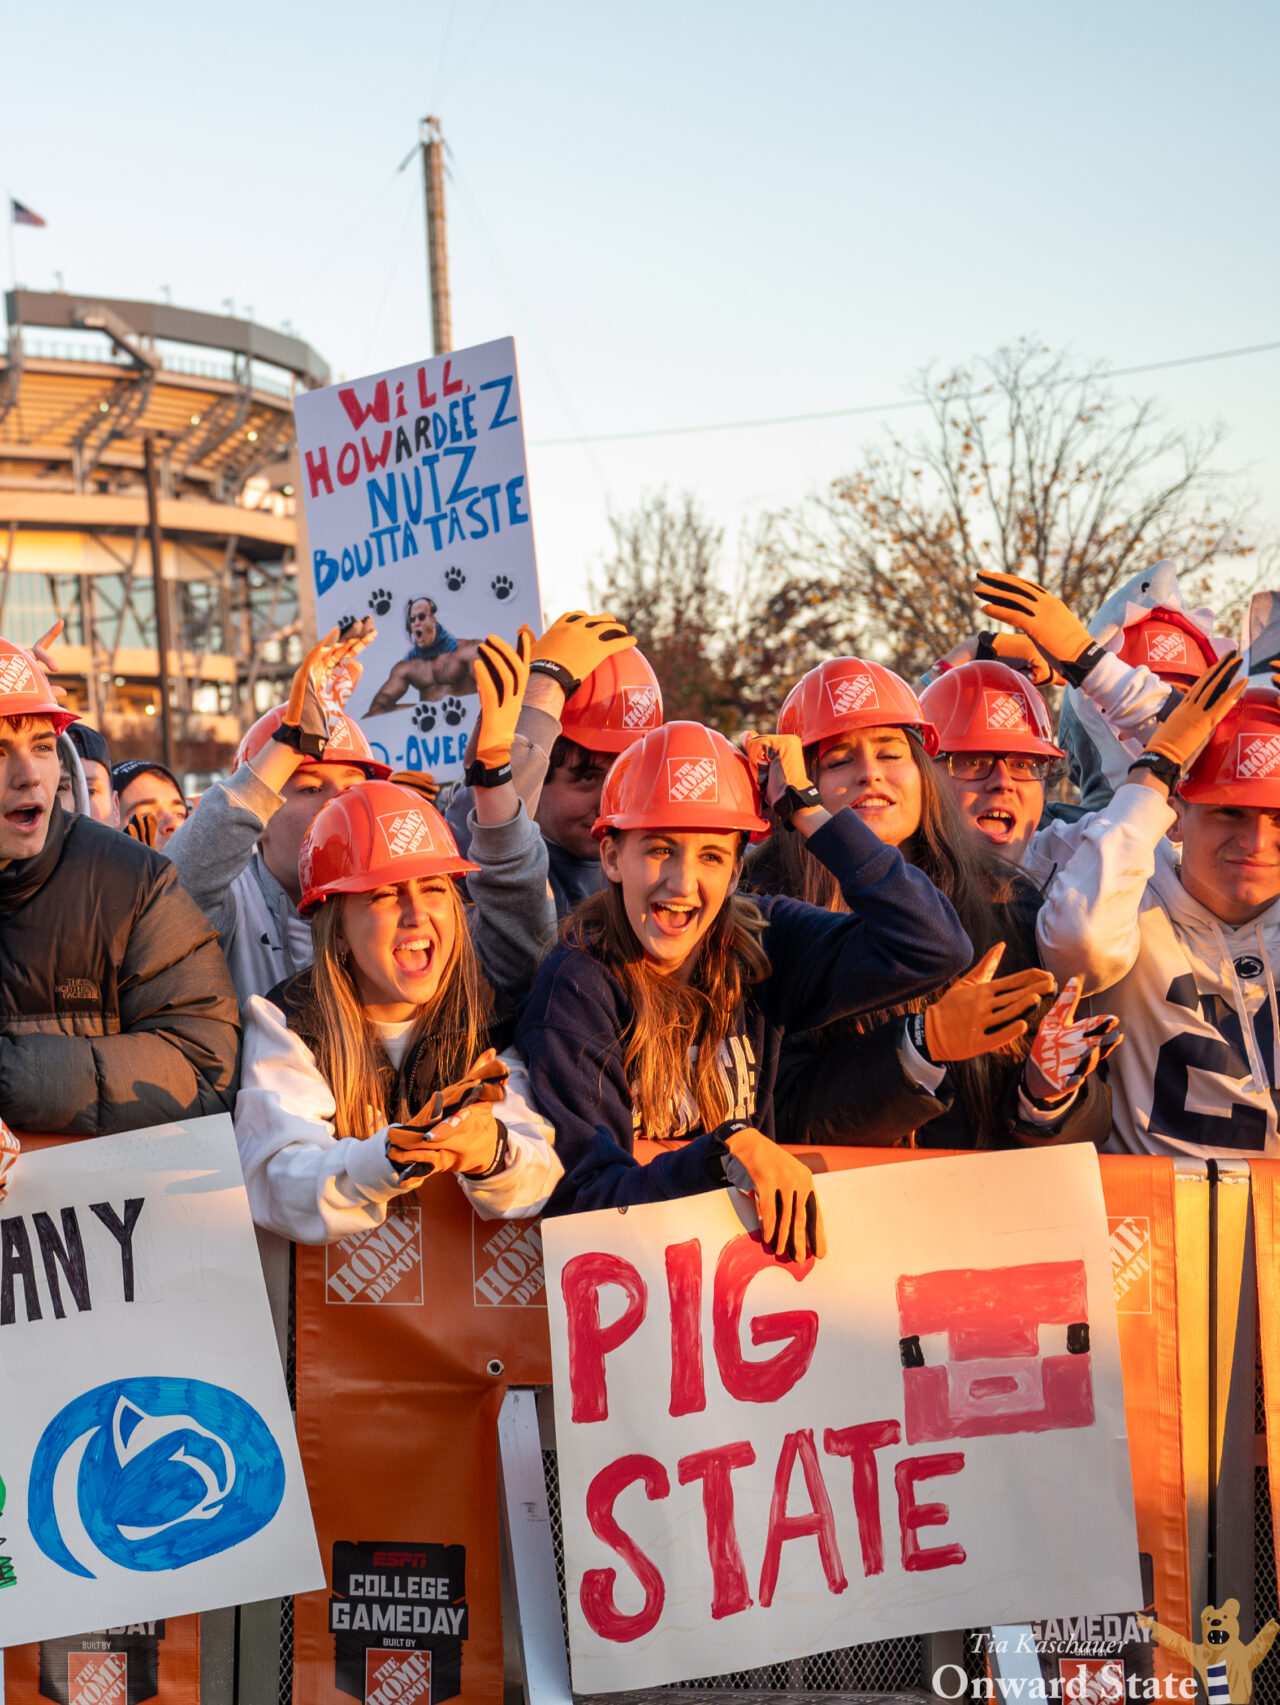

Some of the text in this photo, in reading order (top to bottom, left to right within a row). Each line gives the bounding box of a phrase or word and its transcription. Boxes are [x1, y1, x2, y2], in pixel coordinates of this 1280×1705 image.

[367, 445, 479, 527] NUTZ
[314, 475, 529, 597] BOUTTA TASTE
[1148, 632, 1184, 662] HOME
[1152, 633, 1166, 645] THE
[1164, 645, 1186, 662] DEPOT
[14, 667, 33, 693] DEPOT
[834, 679, 852, 697] THE
[834, 674, 872, 714] HOME
[624, 686, 655, 728] HOME
[628, 690, 642, 707] THE
[852, 686, 876, 711] DEPOT
[987, 692, 1026, 729] HOME
[991, 695, 1008, 710] THE
[638, 701, 657, 728] DEPOT
[1004, 706, 1027, 729] DEPOT
[1244, 738, 1265, 756] THE
[670, 757, 717, 801] HOME
[673, 761, 694, 779] THE
[688, 773, 718, 801] DEPOT
[389, 817, 404, 834] THE
[390, 809, 424, 855] HOME
[408, 823, 429, 853] DEPOT
[482, 1221, 523, 1258] THE
[327, 1214, 421, 1303] HOME
[475, 1219, 544, 1306] HOM
[364, 1243, 422, 1304] DEPOT
[511, 1264, 547, 1306] DEP
[1113, 1253, 1150, 1302] EPOT
[561, 1229, 819, 1424] PIG
[580, 1419, 968, 1643] STATE
[373, 1552, 427, 1568] ESPN
[349, 1574, 450, 1600] COLLEGE
[332, 1602, 466, 1636] GAMEDAY
[82, 1641, 112, 1650] BUILT BY
[382, 1637, 417, 1648] BUILT BY
[75, 1660, 98, 1686] THE
[373, 1656, 401, 1682] THE
